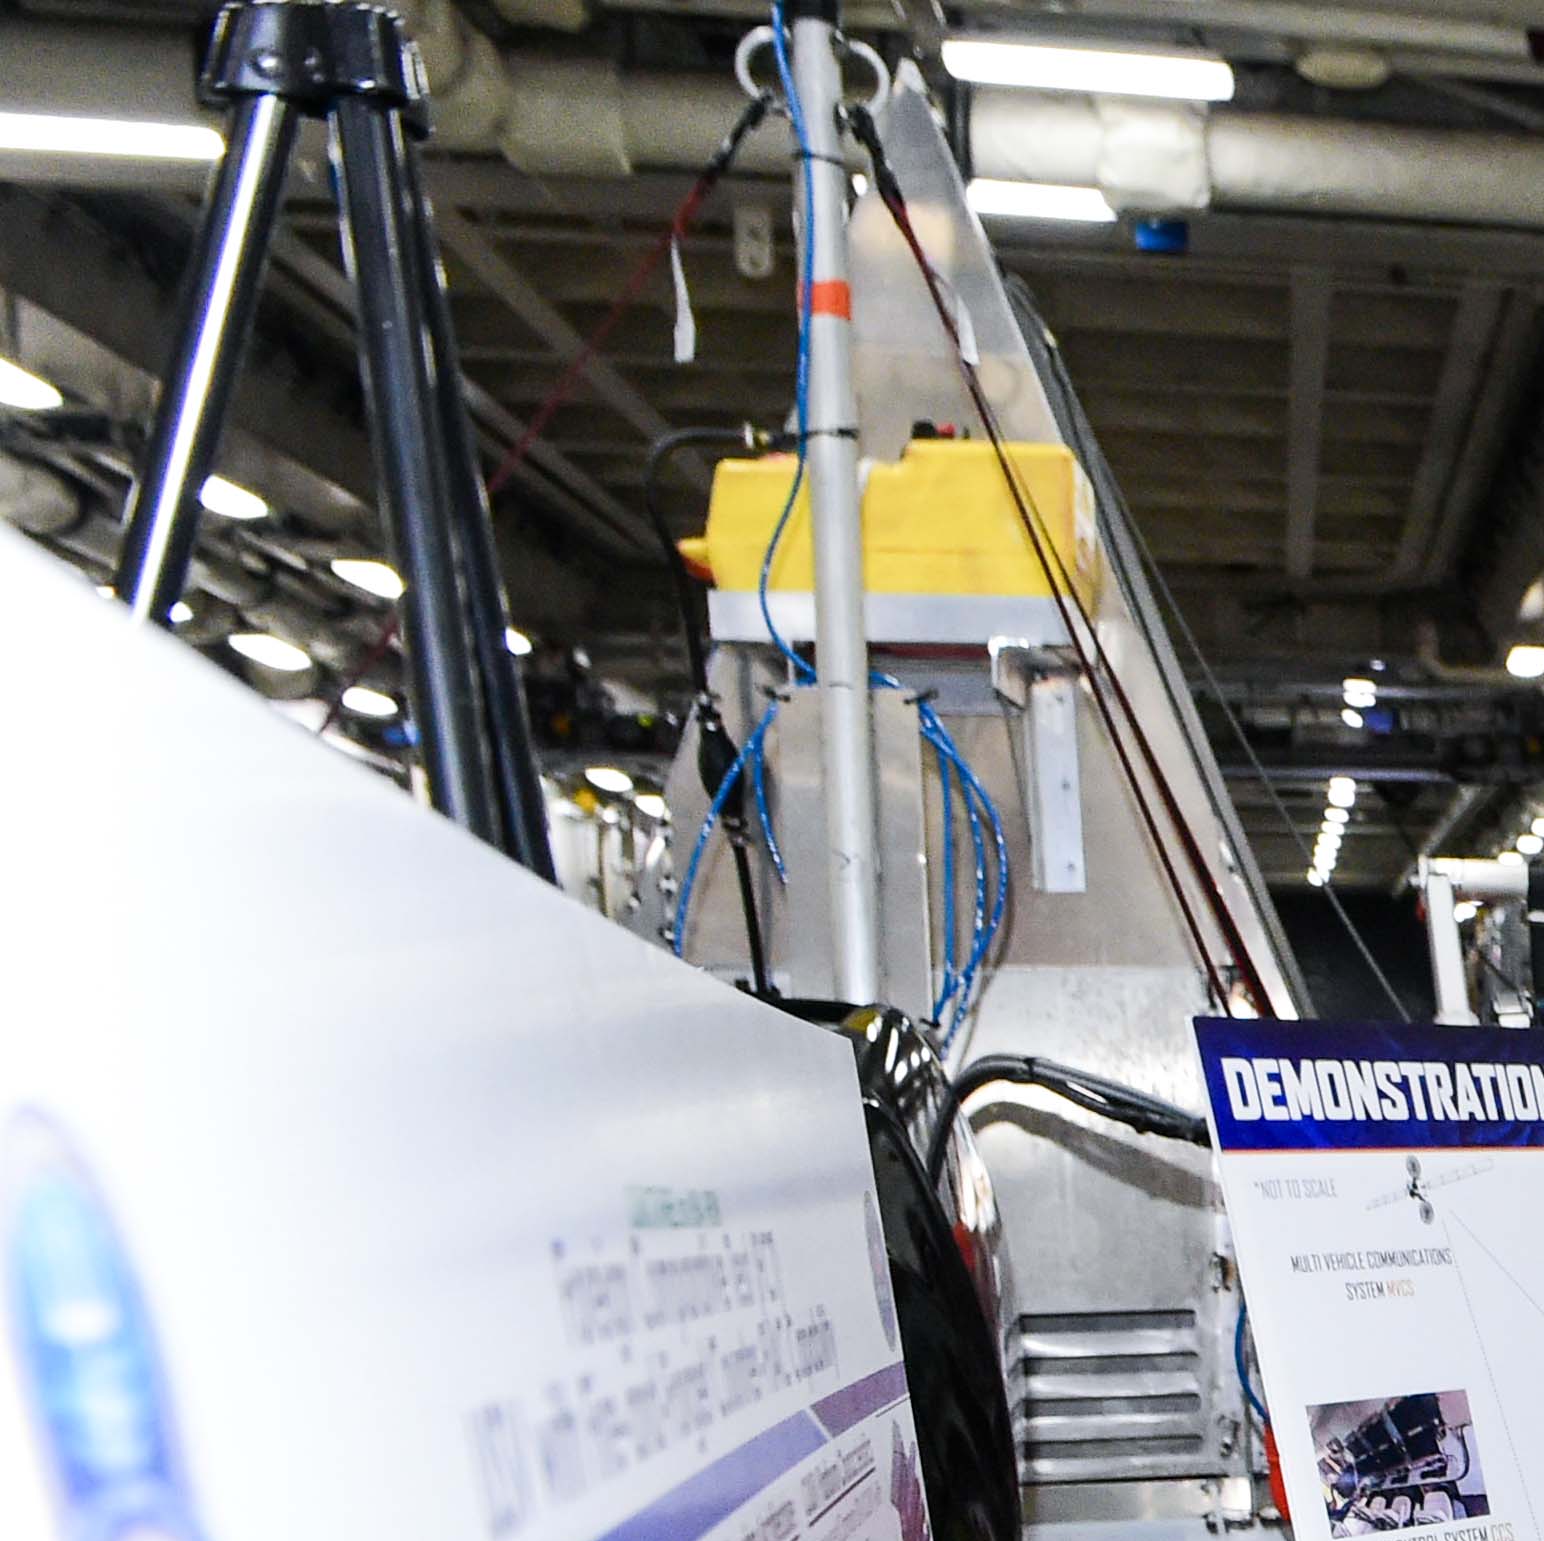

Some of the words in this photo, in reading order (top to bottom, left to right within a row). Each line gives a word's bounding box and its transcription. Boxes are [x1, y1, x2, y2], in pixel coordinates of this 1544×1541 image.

[1290, 1253, 1322, 1273] MULTI
[1322, 1251, 1366, 1271] VEHICLE
[1366, 1248, 1452, 1269] COMMUNICATIONS
[1345, 1280, 1385, 1301] SYSTEM
